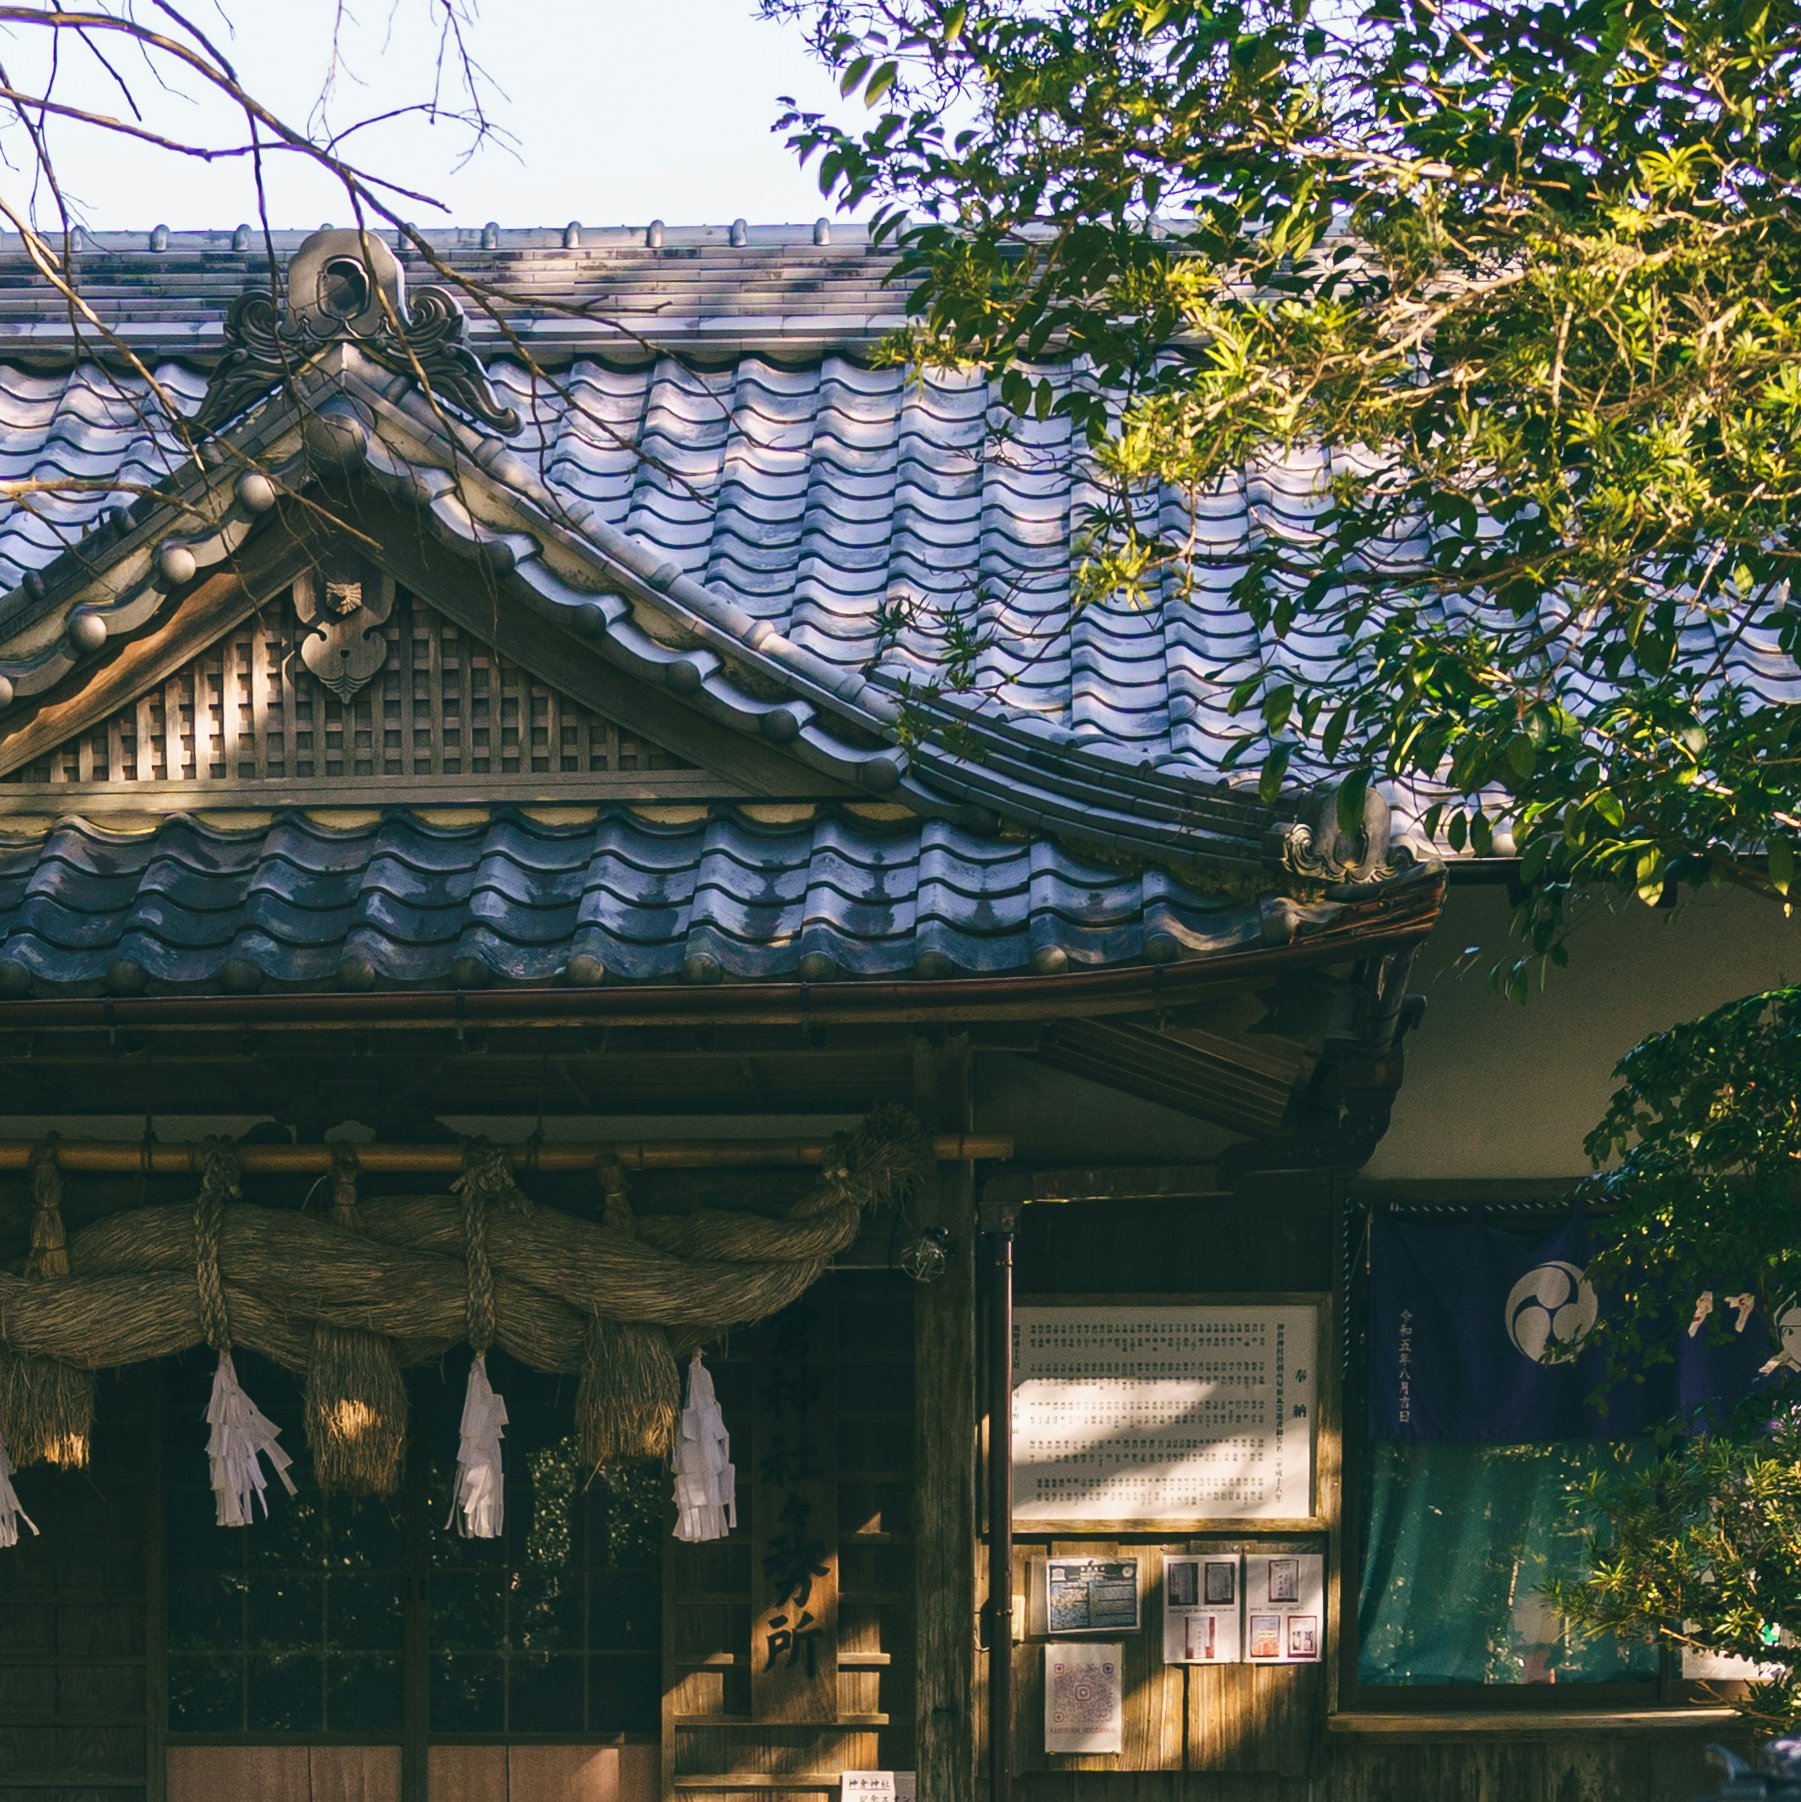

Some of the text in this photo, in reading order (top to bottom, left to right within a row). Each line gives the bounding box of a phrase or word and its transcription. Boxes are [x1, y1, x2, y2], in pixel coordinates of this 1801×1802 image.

[1398, 1308, 1413, 1424] 令和五年八月吉日
[1293, 1368, 1307, 1418] 奉納
[849, 1778, 890, 1790] 神倉神社
